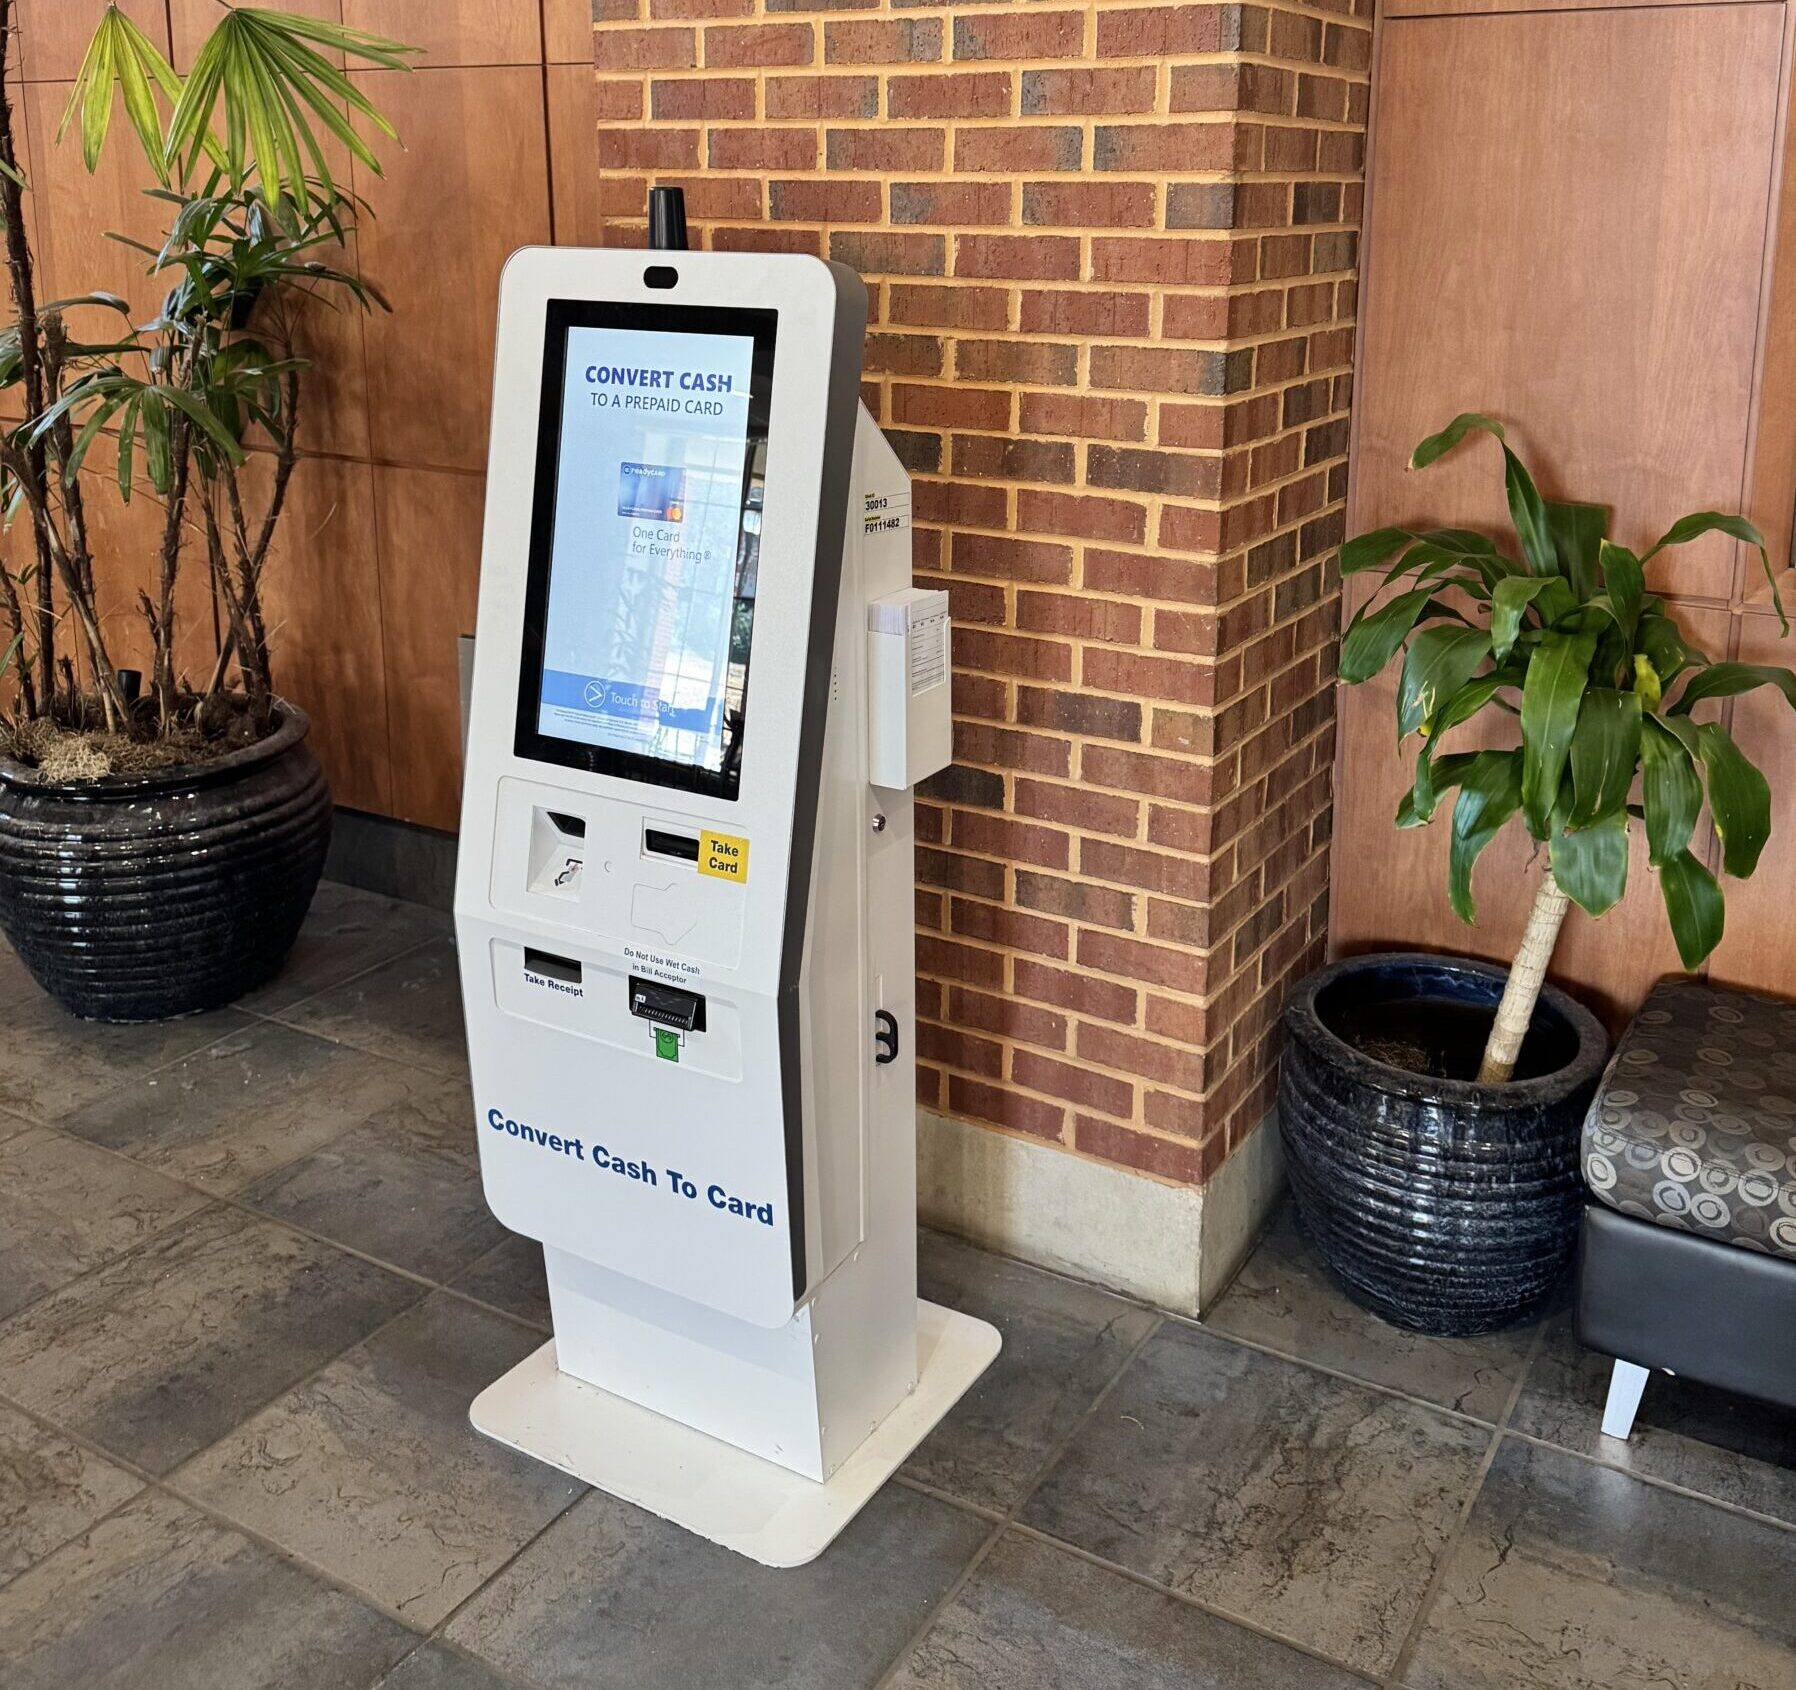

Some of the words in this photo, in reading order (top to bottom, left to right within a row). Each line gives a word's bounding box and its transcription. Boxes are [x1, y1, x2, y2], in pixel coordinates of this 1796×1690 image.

[585, 365, 674, 388] CONVERT
[679, 372, 733, 393] CASH
[590, 392, 608, 407] TO
[611, 394, 621, 408] A
[625, 395, 681, 412] PREPAID
[684, 400, 723, 416] CARD
[865, 498, 888, 511] 30013
[632, 526, 654, 540] One
[656, 529, 680, 542] Card
[865, 518, 900, 533] F0111482
[632, 541, 646, 554] for
[611, 691, 638, 708] Touch
[640, 696, 650, 709] to
[653, 700, 676, 717] Start
[710, 839, 739, 857] Take
[709, 856, 738, 874] Card
[624, 947, 634, 957] Do
[635, 951, 649, 962] Not
[650, 954, 664, 965] Use
[665, 958, 680, 970] Wet
[681, 963, 701, 975] Cash
[640, 965, 652, 975] Bill
[654, 969, 687, 984] Acceptor
[524, 973, 546, 987] Take
[548, 980, 584, 997] Receipt
[487, 1108, 585, 1161] Convert
[592, 1145, 657, 1186] Cash
[666, 1169, 698, 1199] To
[707, 1184, 774, 1227] Card
